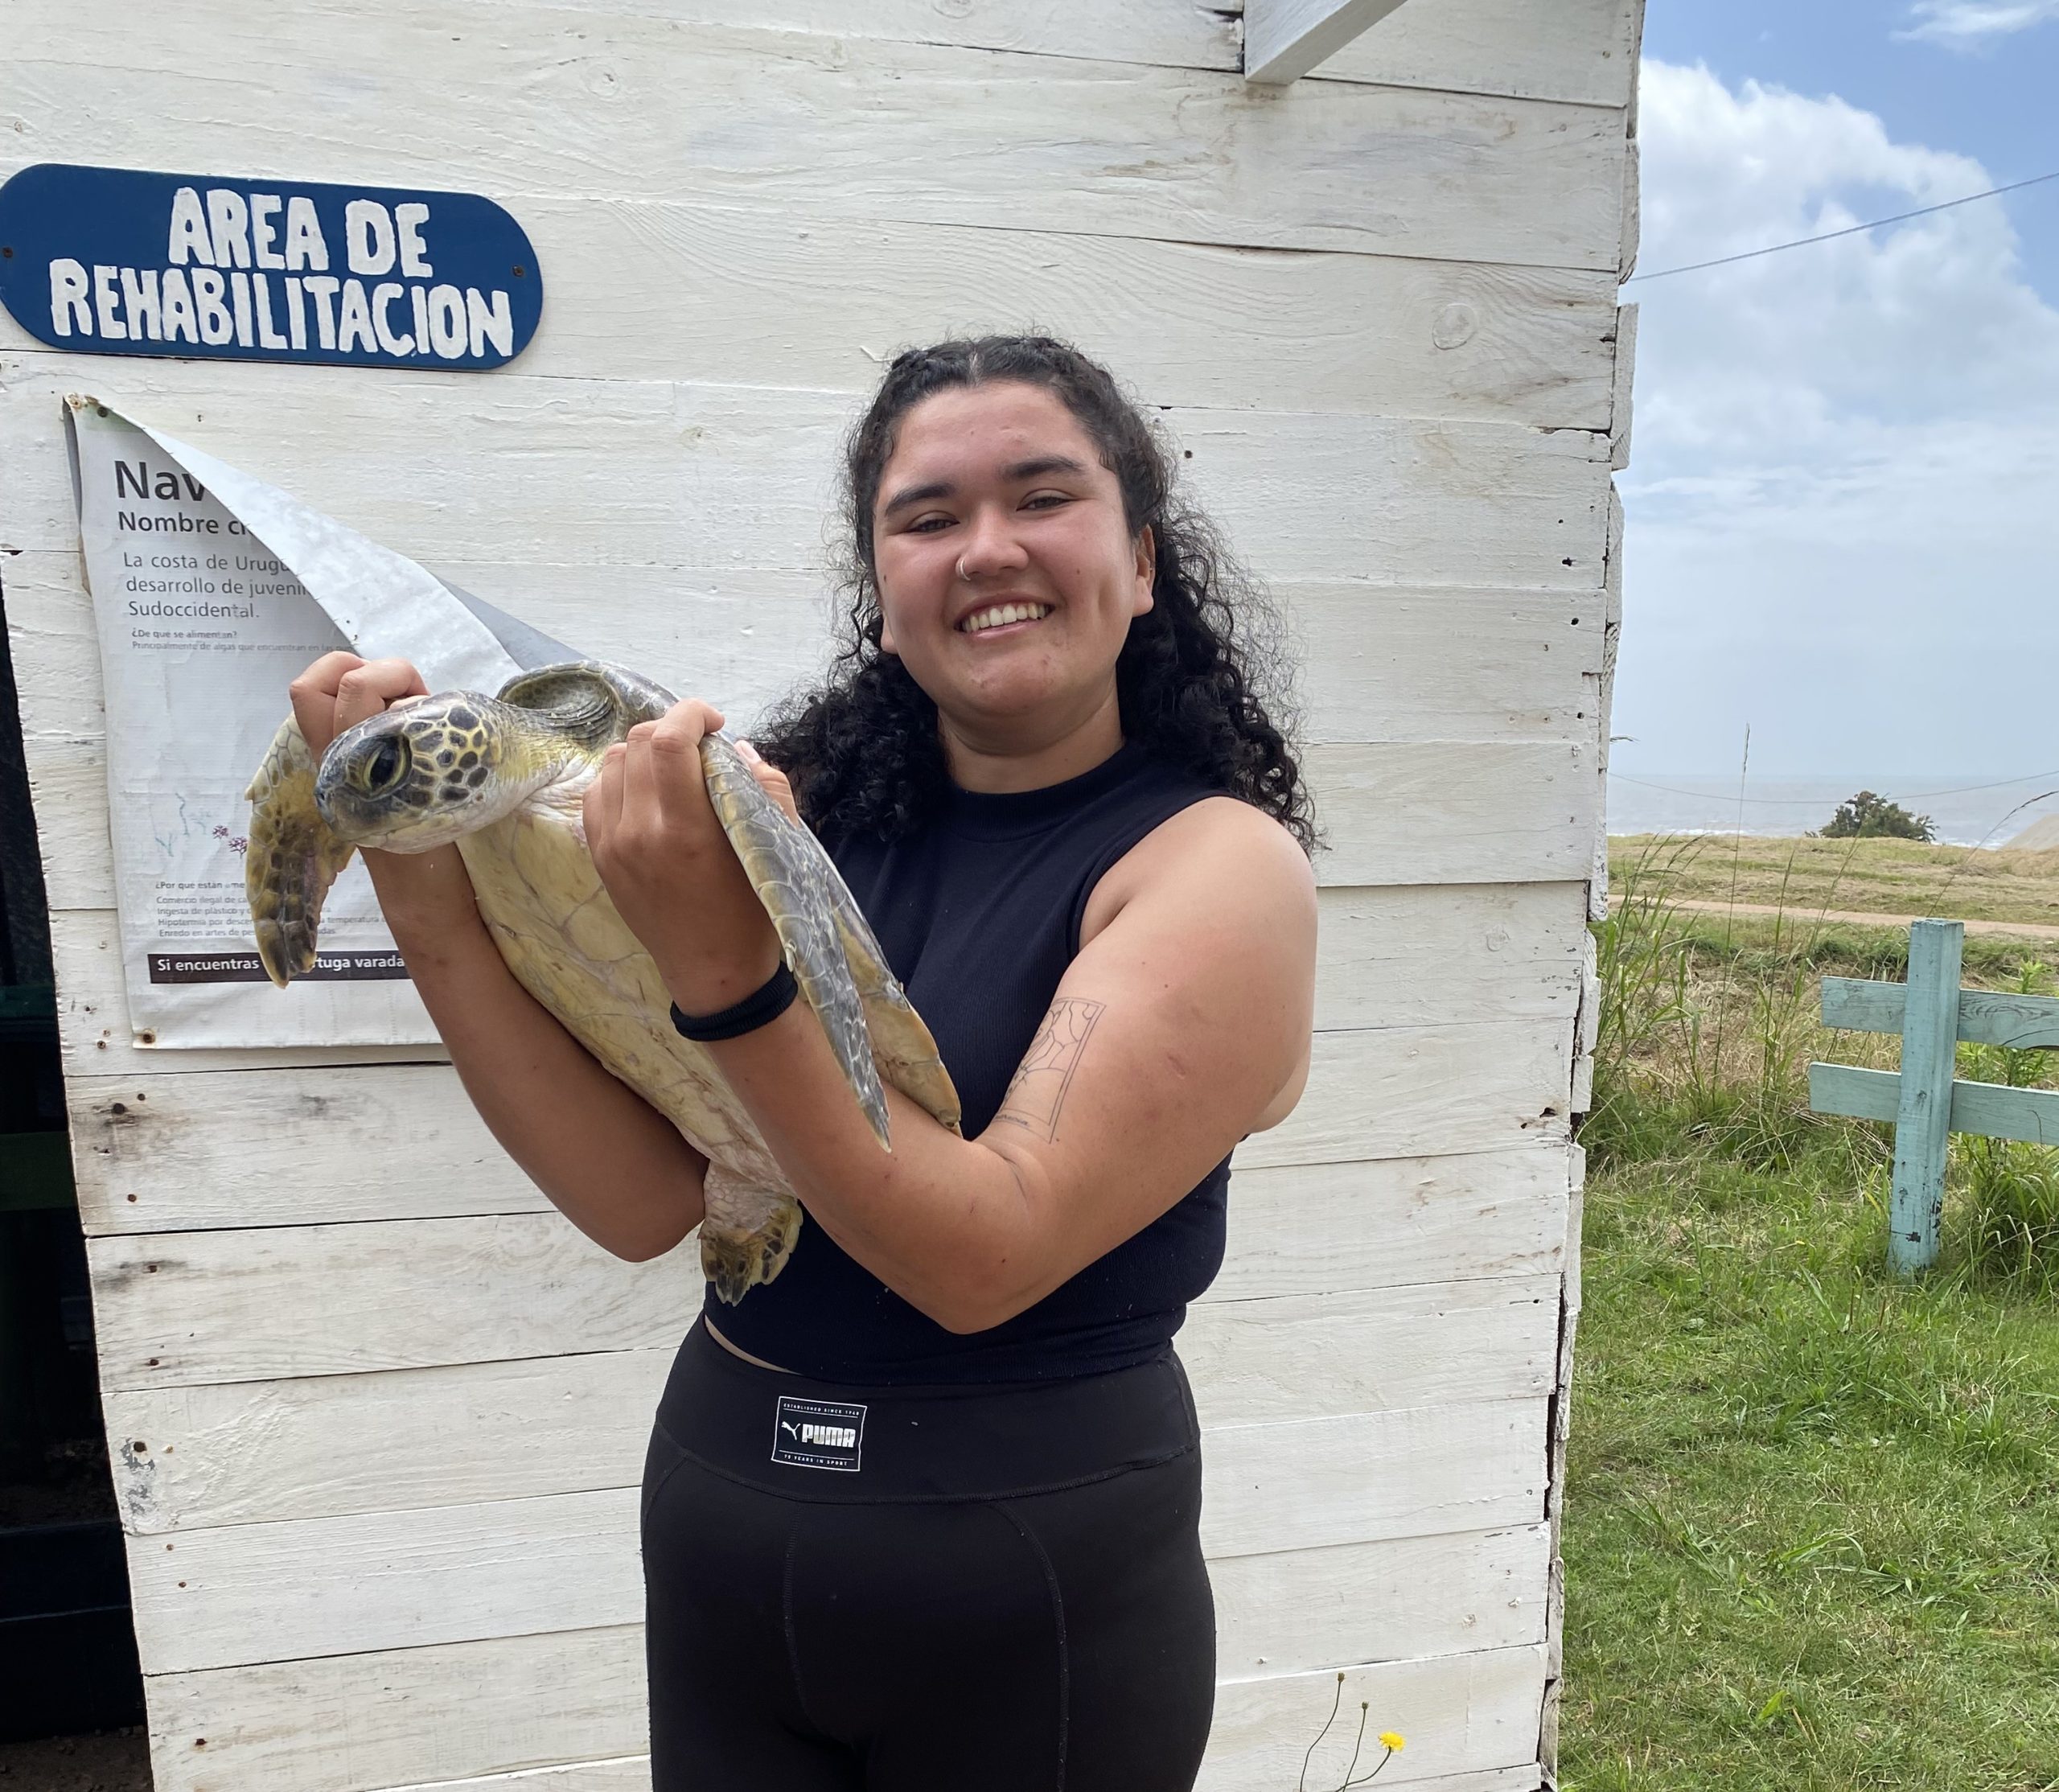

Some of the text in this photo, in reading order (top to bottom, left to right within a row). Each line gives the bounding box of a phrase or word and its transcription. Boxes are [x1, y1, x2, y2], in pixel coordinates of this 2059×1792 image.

[168, 187, 434, 278] AREA DE
[48, 257, 515, 360] REHABILITACION
[118, 511, 220, 534] Nombre
[124, 552, 142, 568] La
[151, 554, 198, 569] costa
[206, 553, 228, 570] de
[126, 576, 215, 594] desarrollo
[221, 578, 244, 594] de
[128, 600, 260, 619] Sudoccidental.
[174, 631, 184, 639] se
[157, 907, 189, 917] Ingesta
[157, 958, 171, 972] Si
[175, 958, 260, 972] encuentras
[354, 954, 405, 968] varada
[801, 1424, 856, 1448] PUMA
